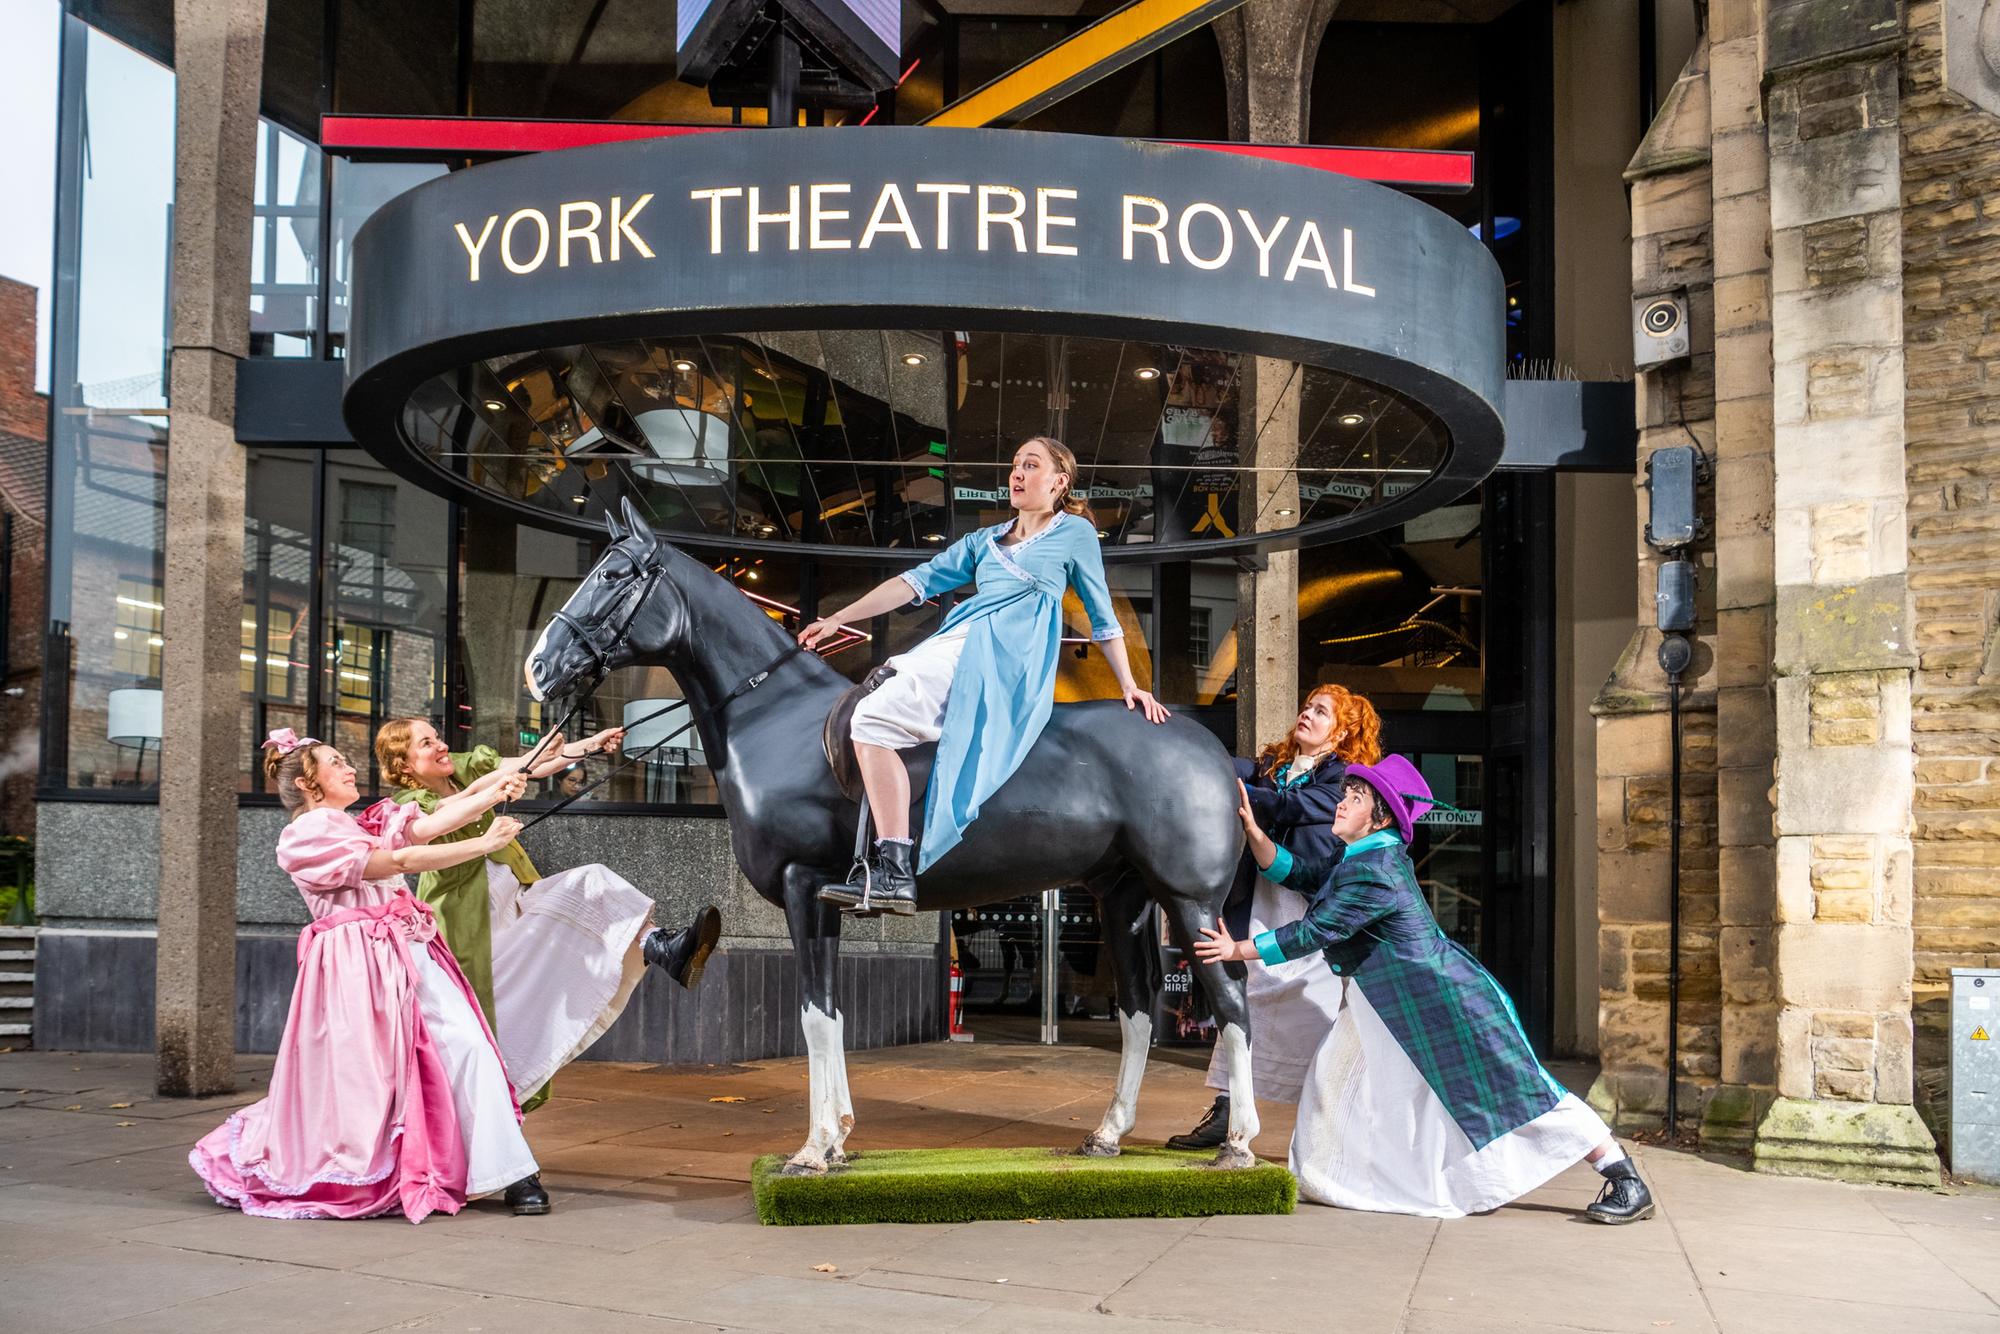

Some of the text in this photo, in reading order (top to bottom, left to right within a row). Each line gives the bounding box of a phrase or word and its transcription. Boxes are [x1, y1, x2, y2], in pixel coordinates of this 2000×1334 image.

[453, 182, 1376, 298] YORK THEATRE ROYAL
[1445, 812, 1477, 823] ONLY
[1164, 983, 1189, 992] HIRE
